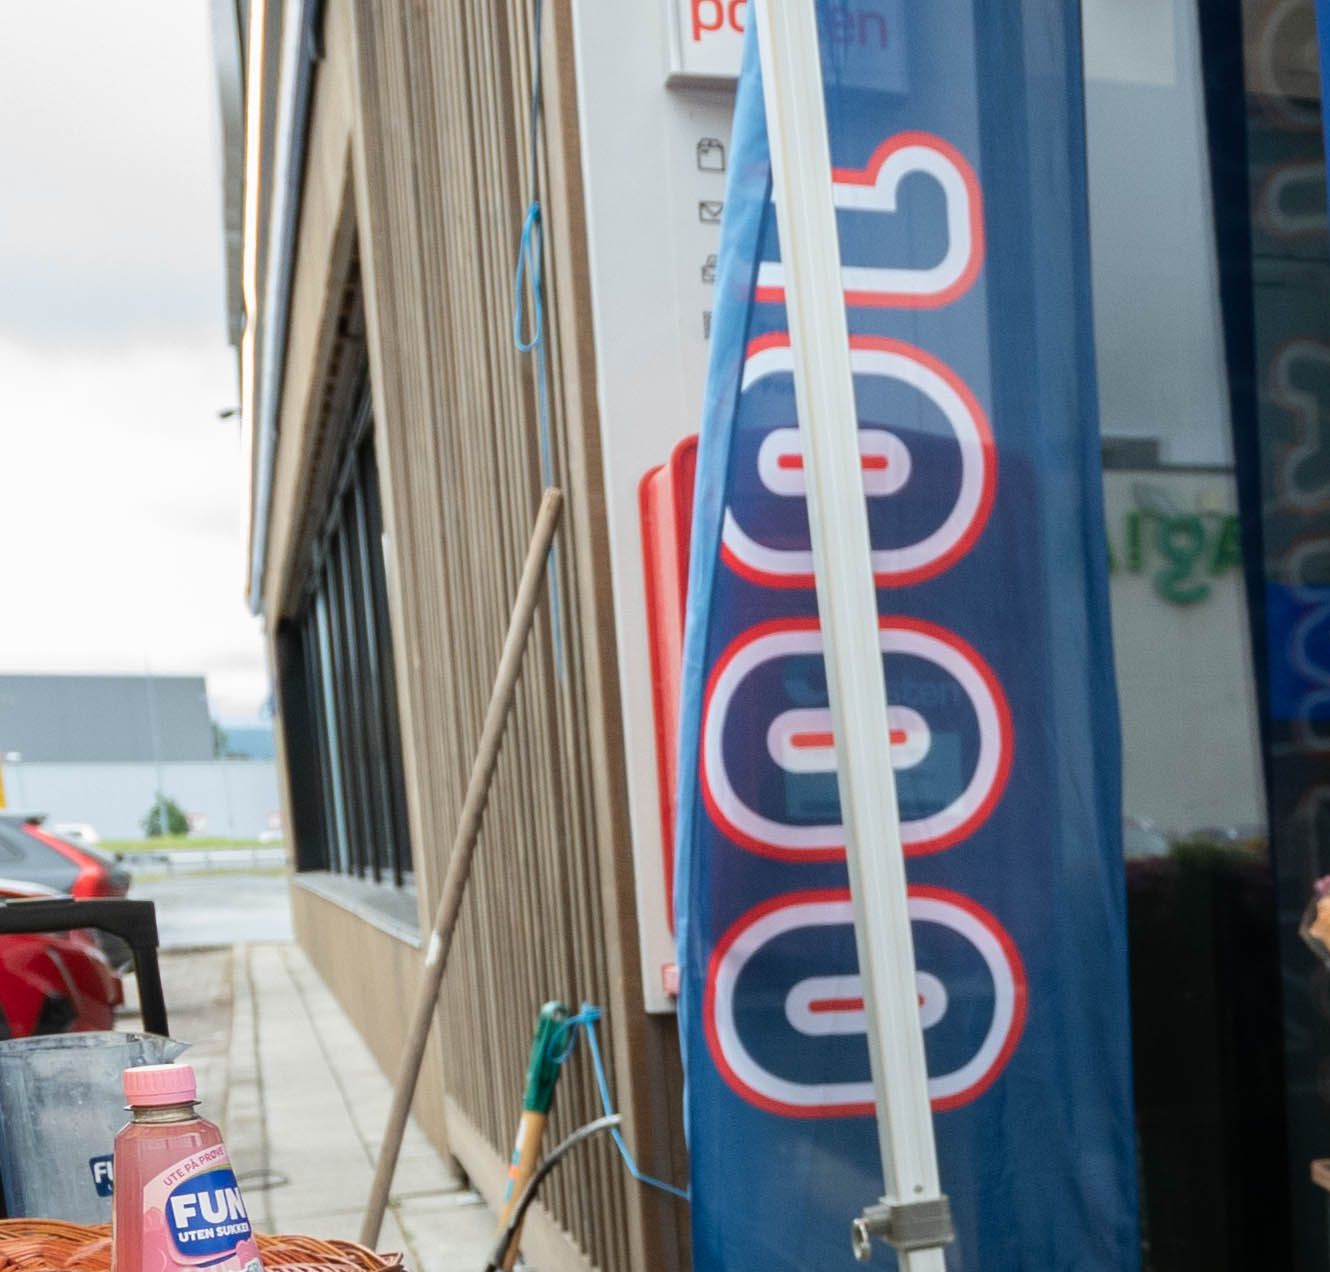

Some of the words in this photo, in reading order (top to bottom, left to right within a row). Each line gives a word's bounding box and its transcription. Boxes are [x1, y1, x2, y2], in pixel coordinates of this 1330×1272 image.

[163, 1170, 185, 1187] UTE
[170, 1187, 248, 1229] FUN
[178, 1229, 215, 1243] UTEN
